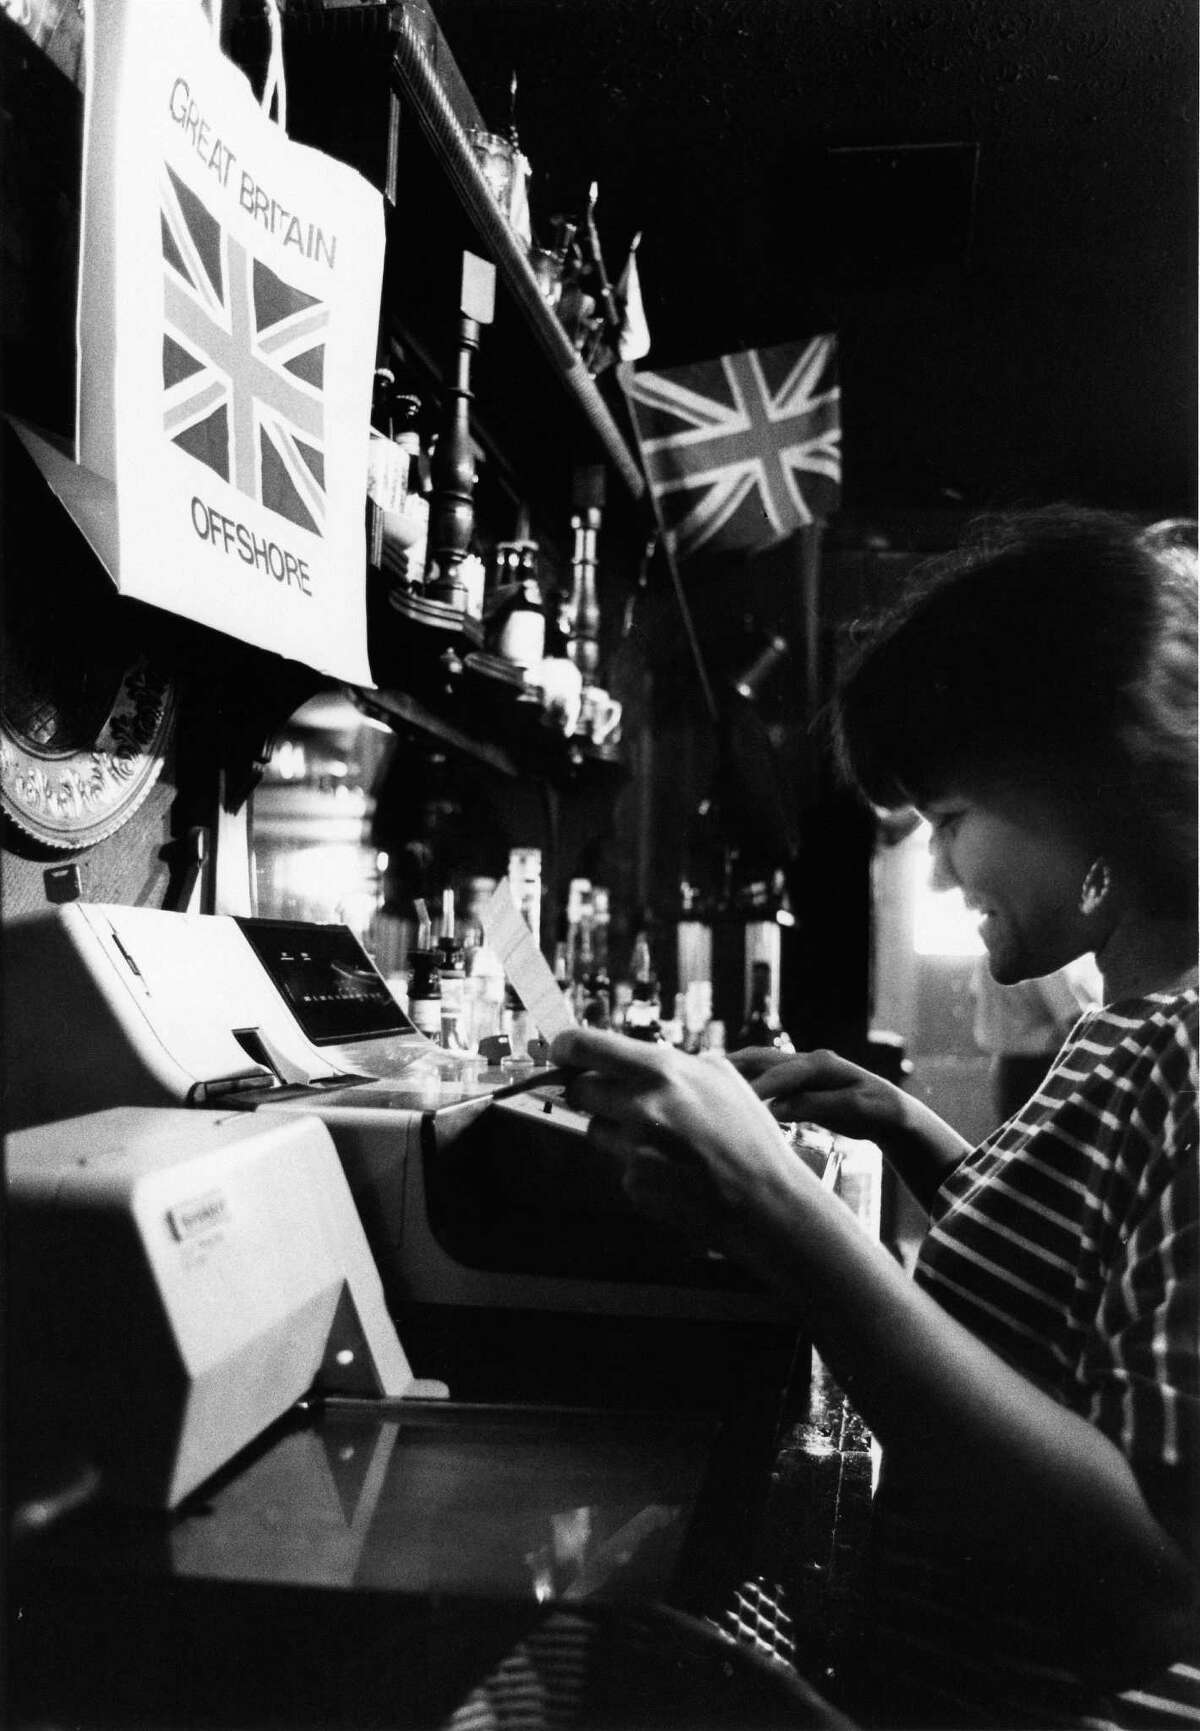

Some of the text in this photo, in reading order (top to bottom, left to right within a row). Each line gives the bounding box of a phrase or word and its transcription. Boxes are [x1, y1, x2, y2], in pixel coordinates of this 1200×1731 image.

[169, 77, 337, 269] GREAT BRITAIN
[190, 495, 313, 597] OFFSHORE
